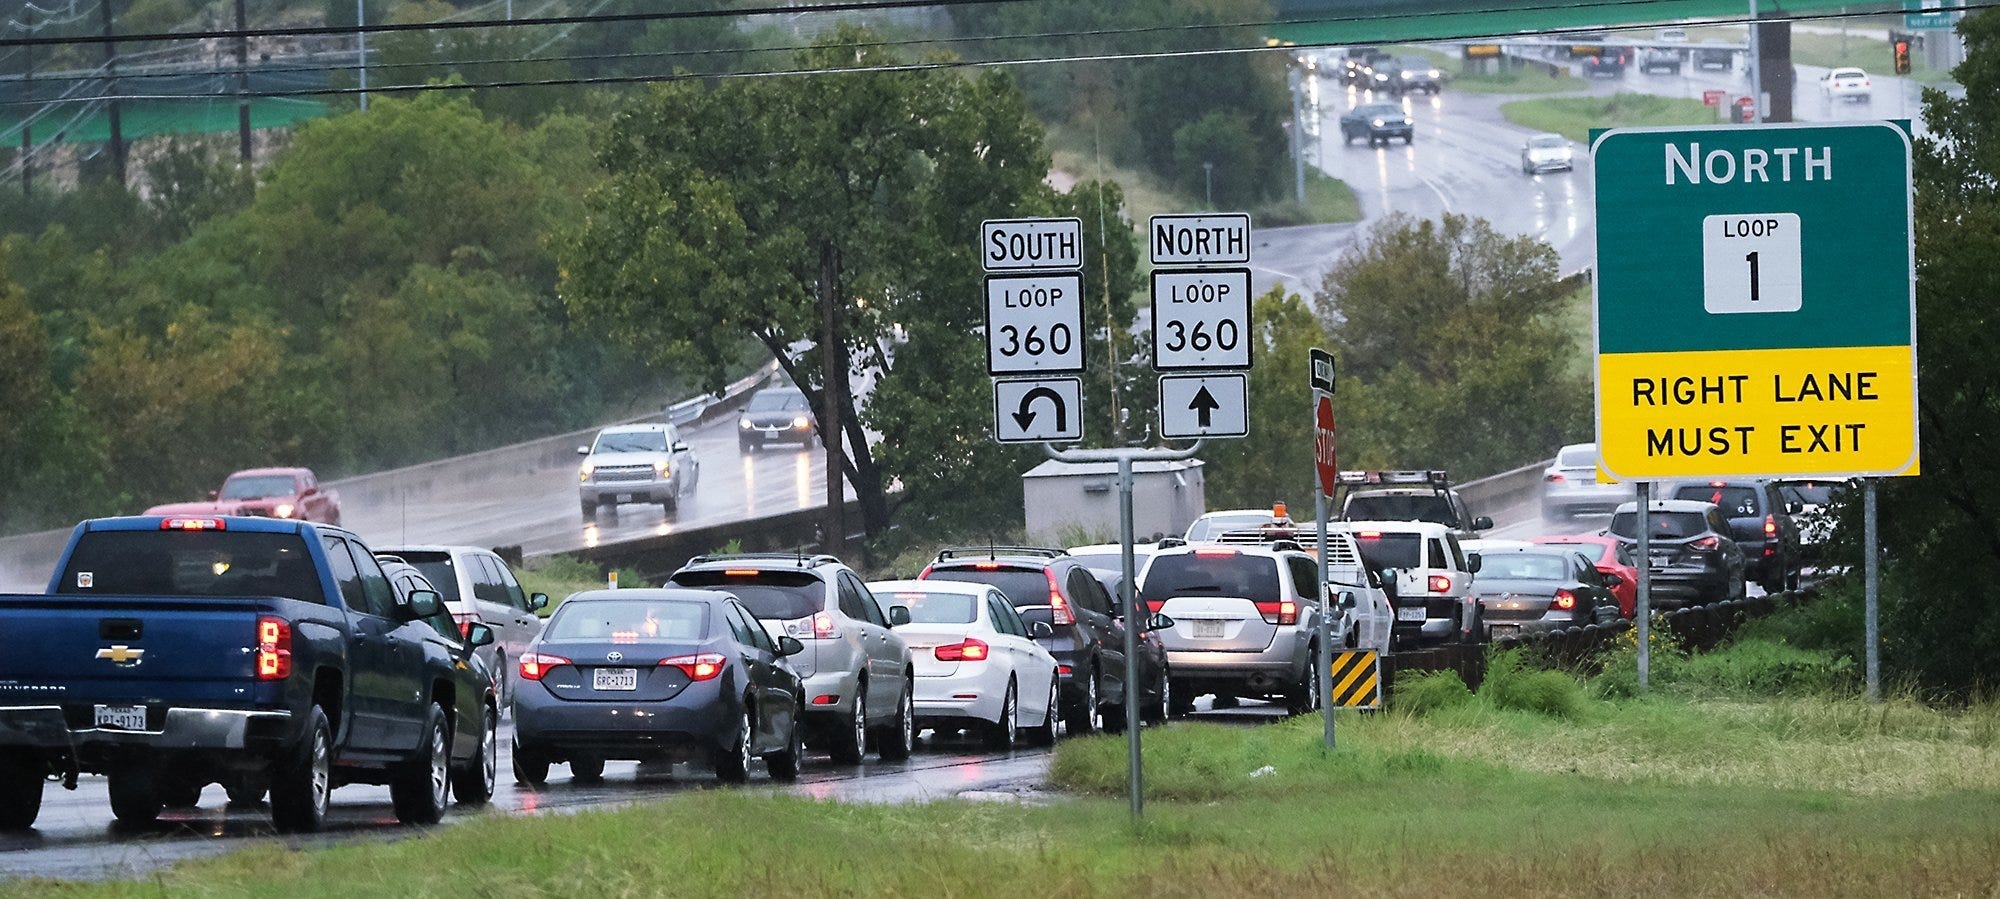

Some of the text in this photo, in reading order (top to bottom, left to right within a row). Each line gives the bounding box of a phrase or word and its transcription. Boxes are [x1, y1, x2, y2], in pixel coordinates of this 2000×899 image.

[1665, 142, 1832, 185] NORTH
[1157, 224, 1243, 255] NORTH
[1724, 219, 1779, 238] LOOP
[990, 230, 1075, 261] SOUTH
[1745, 251, 1760, 301] 1
[1005, 288, 1063, 308] LOOP
[1172, 284, 1231, 303] LOOP
[999, 323, 1072, 356] 360
[1165, 319, 1238, 352] 360
[1633, 372, 1879, 406] RIGHT LANE
[1647, 423, 1866, 457] MUST EXIT
[596, 676, 634, 686] GRC-1713
